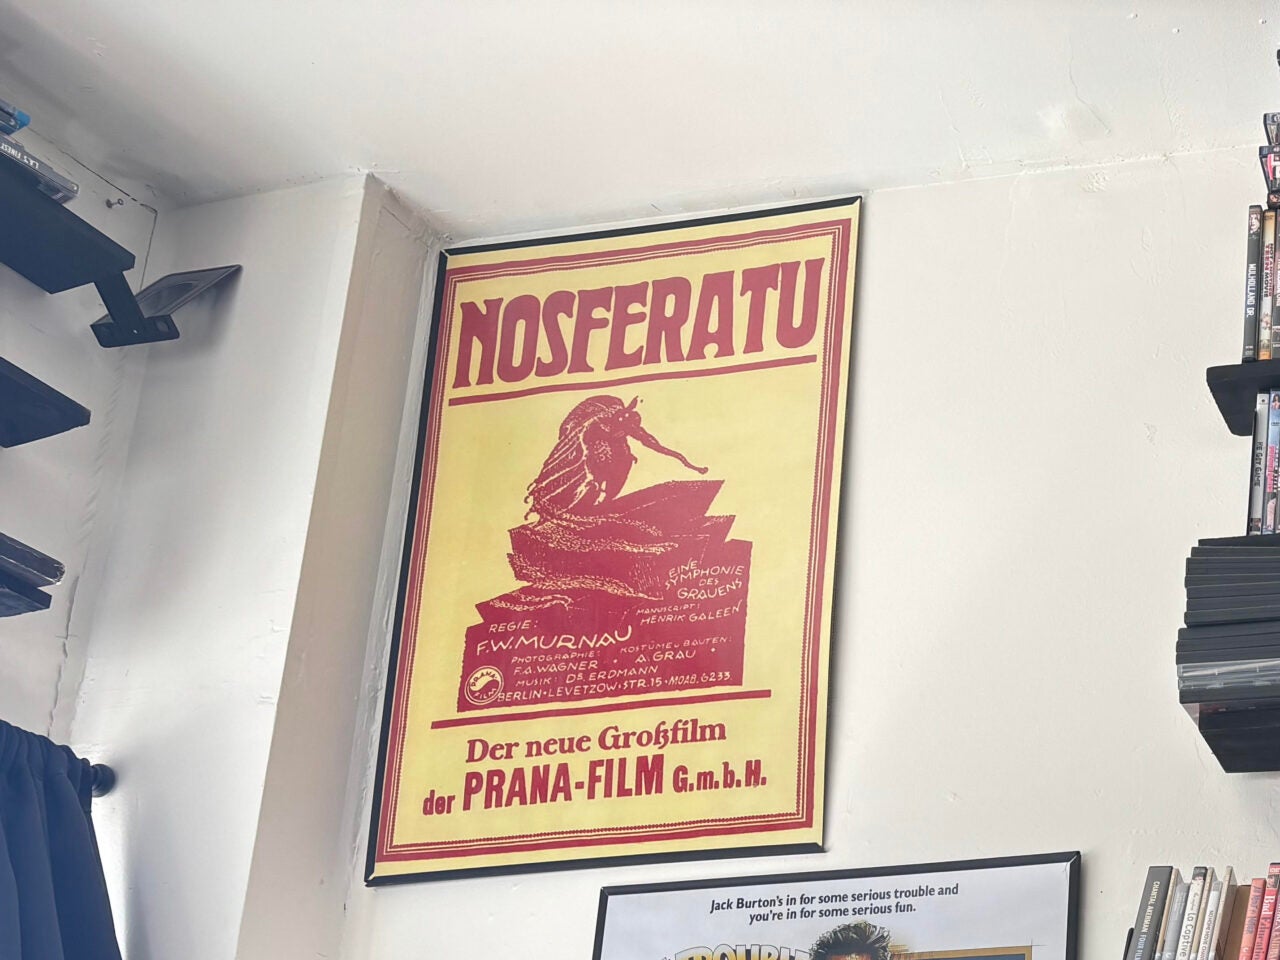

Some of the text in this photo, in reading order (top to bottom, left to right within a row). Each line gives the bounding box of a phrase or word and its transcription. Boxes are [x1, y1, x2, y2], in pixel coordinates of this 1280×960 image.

[451, 256, 826, 389] NOSFERATU
[665, 565, 744, 590] SYMPHONIE
[669, 557, 698, 578] EINE
[677, 577, 743, 600] GRAUENS
[699, 578, 719, 587] DES
[640, 600, 742, 625] HENRIK GALEEN
[653, 650, 697, 662] GRAU
[589, 665, 658, 682] ERDMANN
[466, 738, 518, 763] Der
[525, 732, 592, 758] neue
[422, 790, 456, 816] der
[463, 753, 665, 812] PRANA-FILM
[710, 883, 959, 914] Jack Burton's in for some serious trouble and
[749, 901, 917, 925] you're in for some serious fun.
